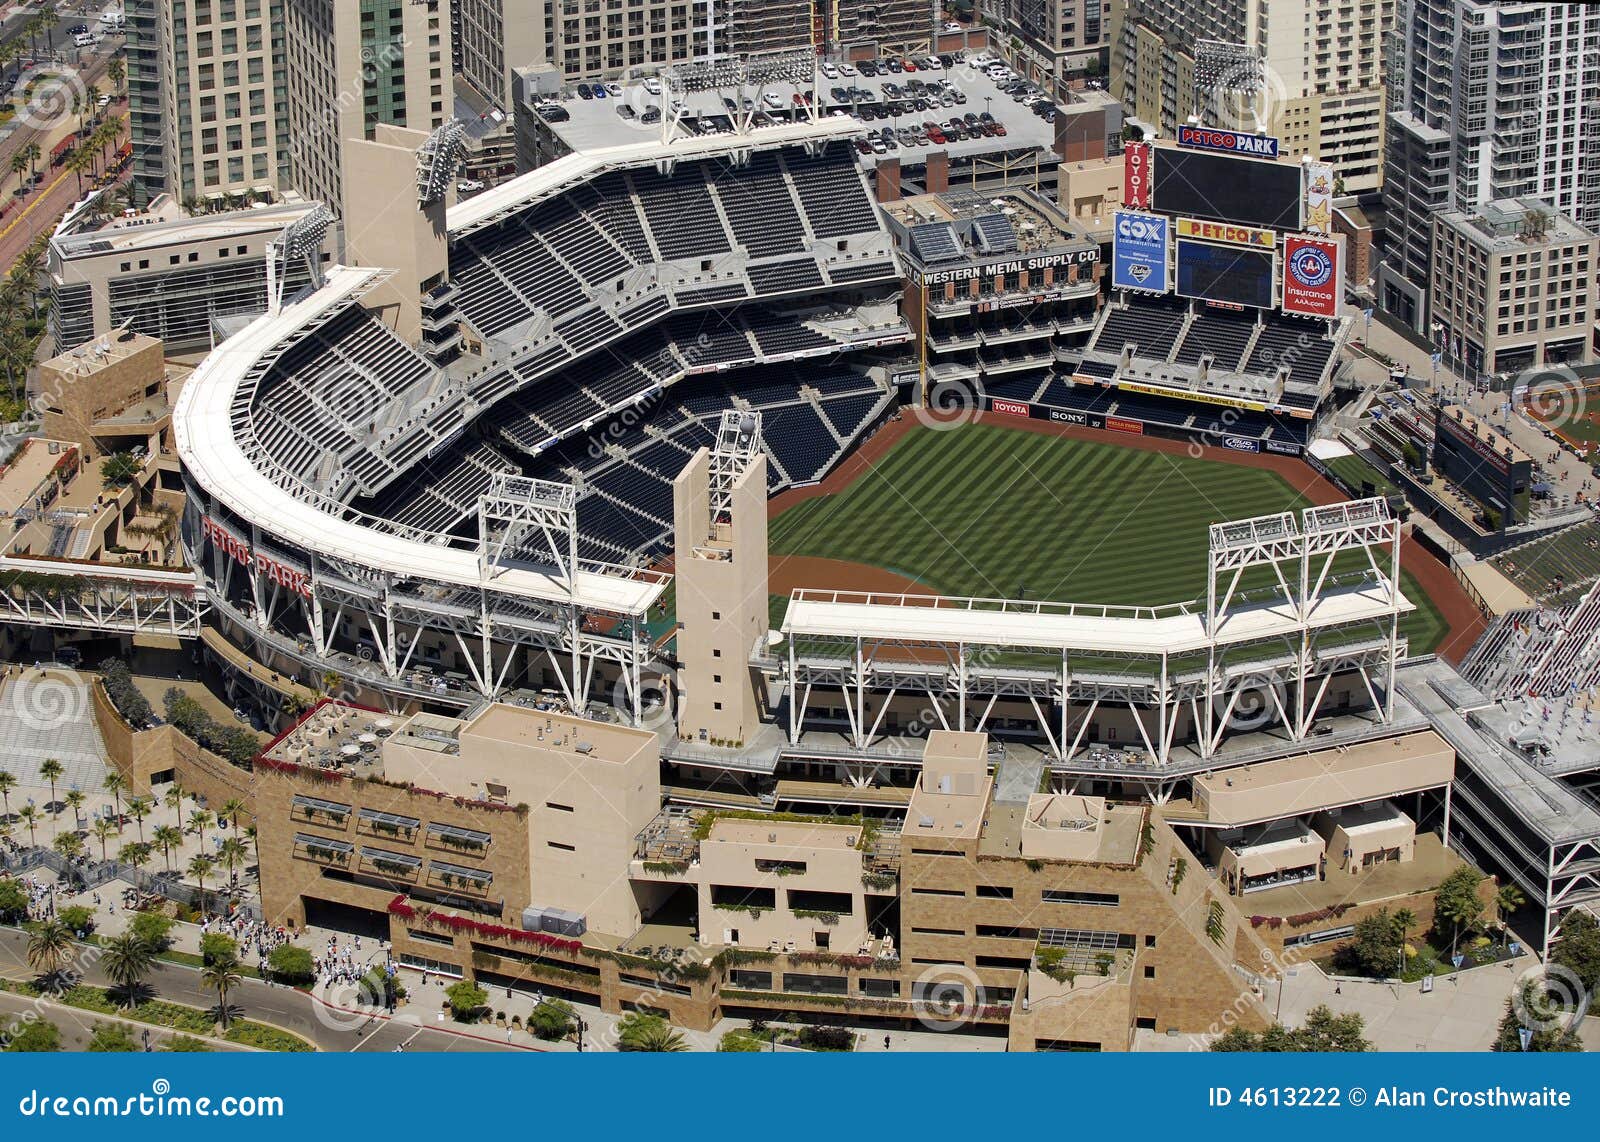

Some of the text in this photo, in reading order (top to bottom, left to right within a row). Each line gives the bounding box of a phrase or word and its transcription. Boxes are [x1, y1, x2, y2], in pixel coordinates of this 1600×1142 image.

[1183, 128, 1274, 154] PETCO PARK
[1131, 144, 1141, 206] TOYOTA
[1119, 219, 1162, 241] COX
[1191, 222, 1249, 243] PETCO
[924, 247, 1099, 285] WESTERN METAL SUPPLY CO.
[1301, 260, 1321, 272] AAA
[1287, 286, 1333, 300] Insurance
[1294, 298, 1325, 308] AAA.com
[994, 402, 1027, 414] TOYOTA
[1052, 411, 1083, 423] SONY
[1231, 443, 1256, 451] LIGHT
[1232, 438, 1253, 446] BUD
[202, 515, 311, 598] PETCO PARK
